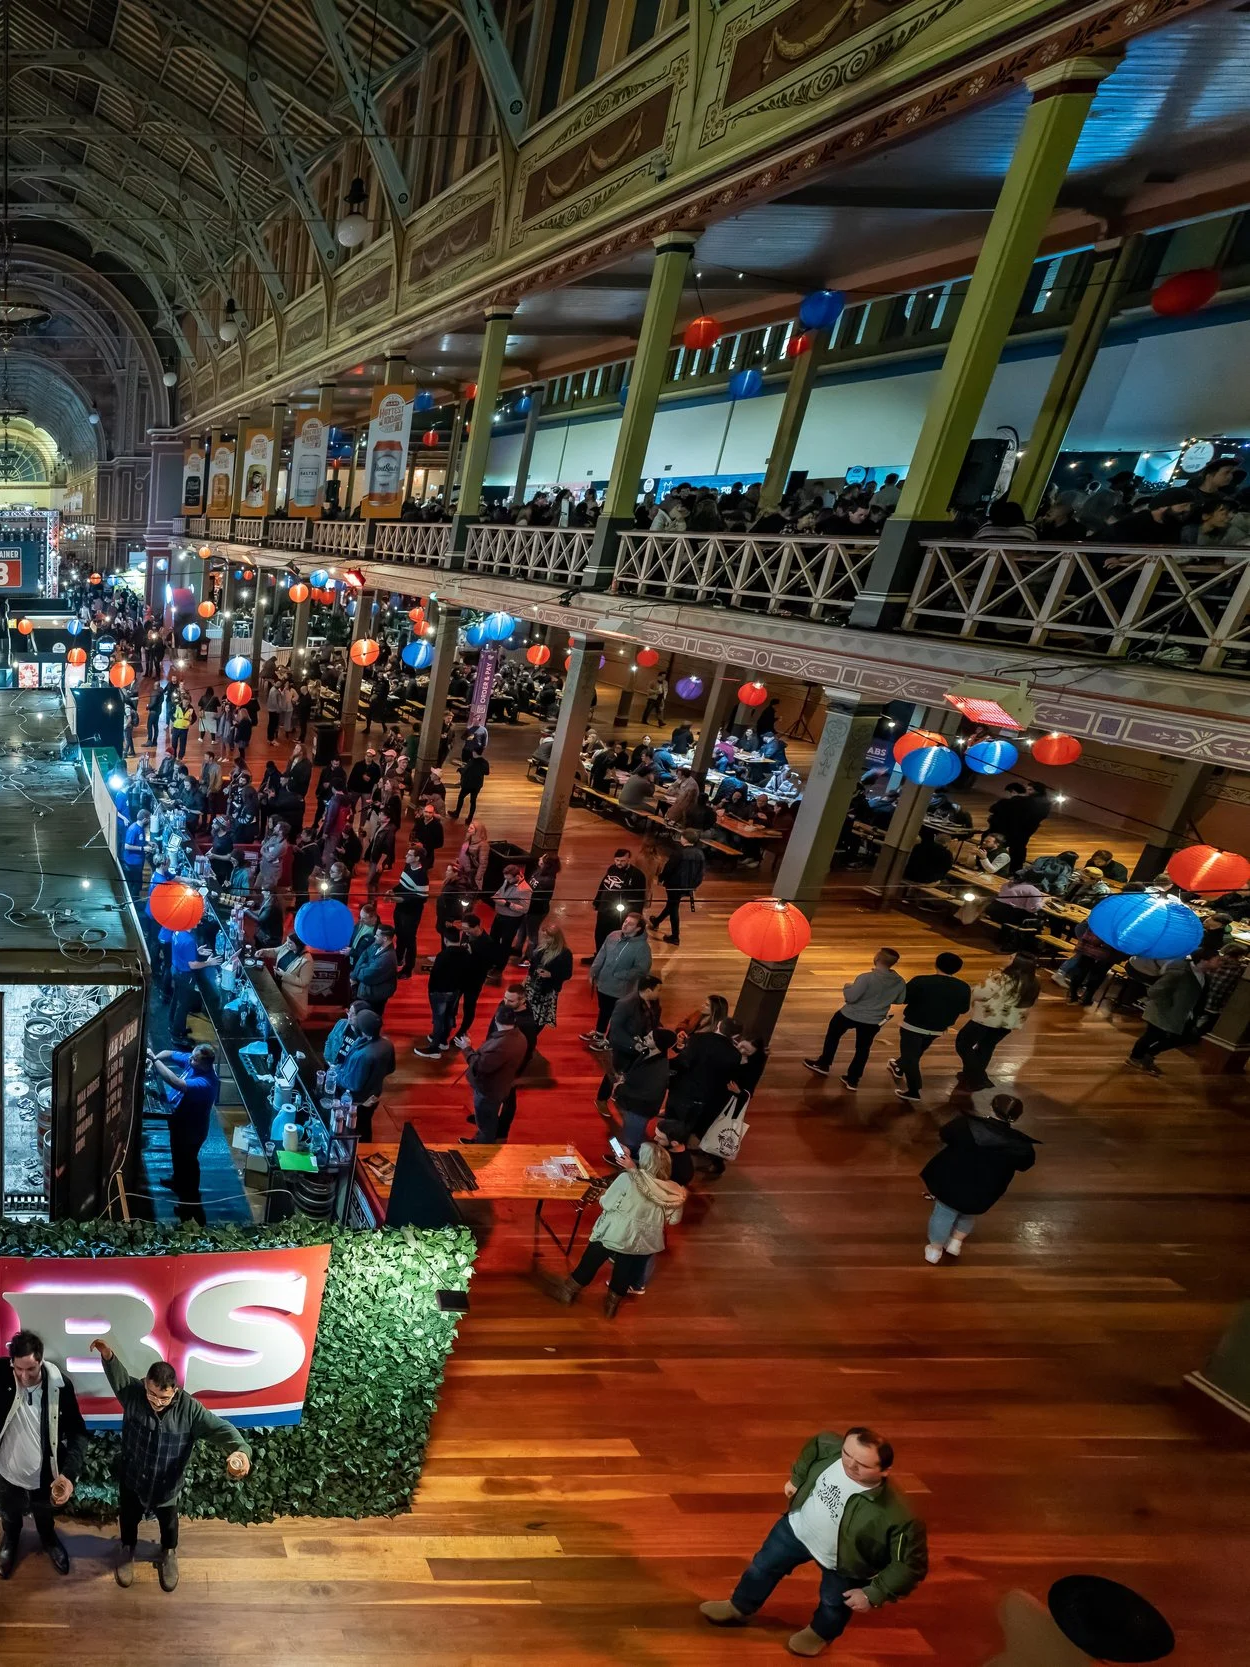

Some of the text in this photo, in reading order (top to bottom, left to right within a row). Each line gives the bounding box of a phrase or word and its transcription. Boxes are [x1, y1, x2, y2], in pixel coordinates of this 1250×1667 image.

[1193, 446, 1206, 454] 71
[480, 682, 489, 703] ORDER
[867, 747, 887, 756] ABS
